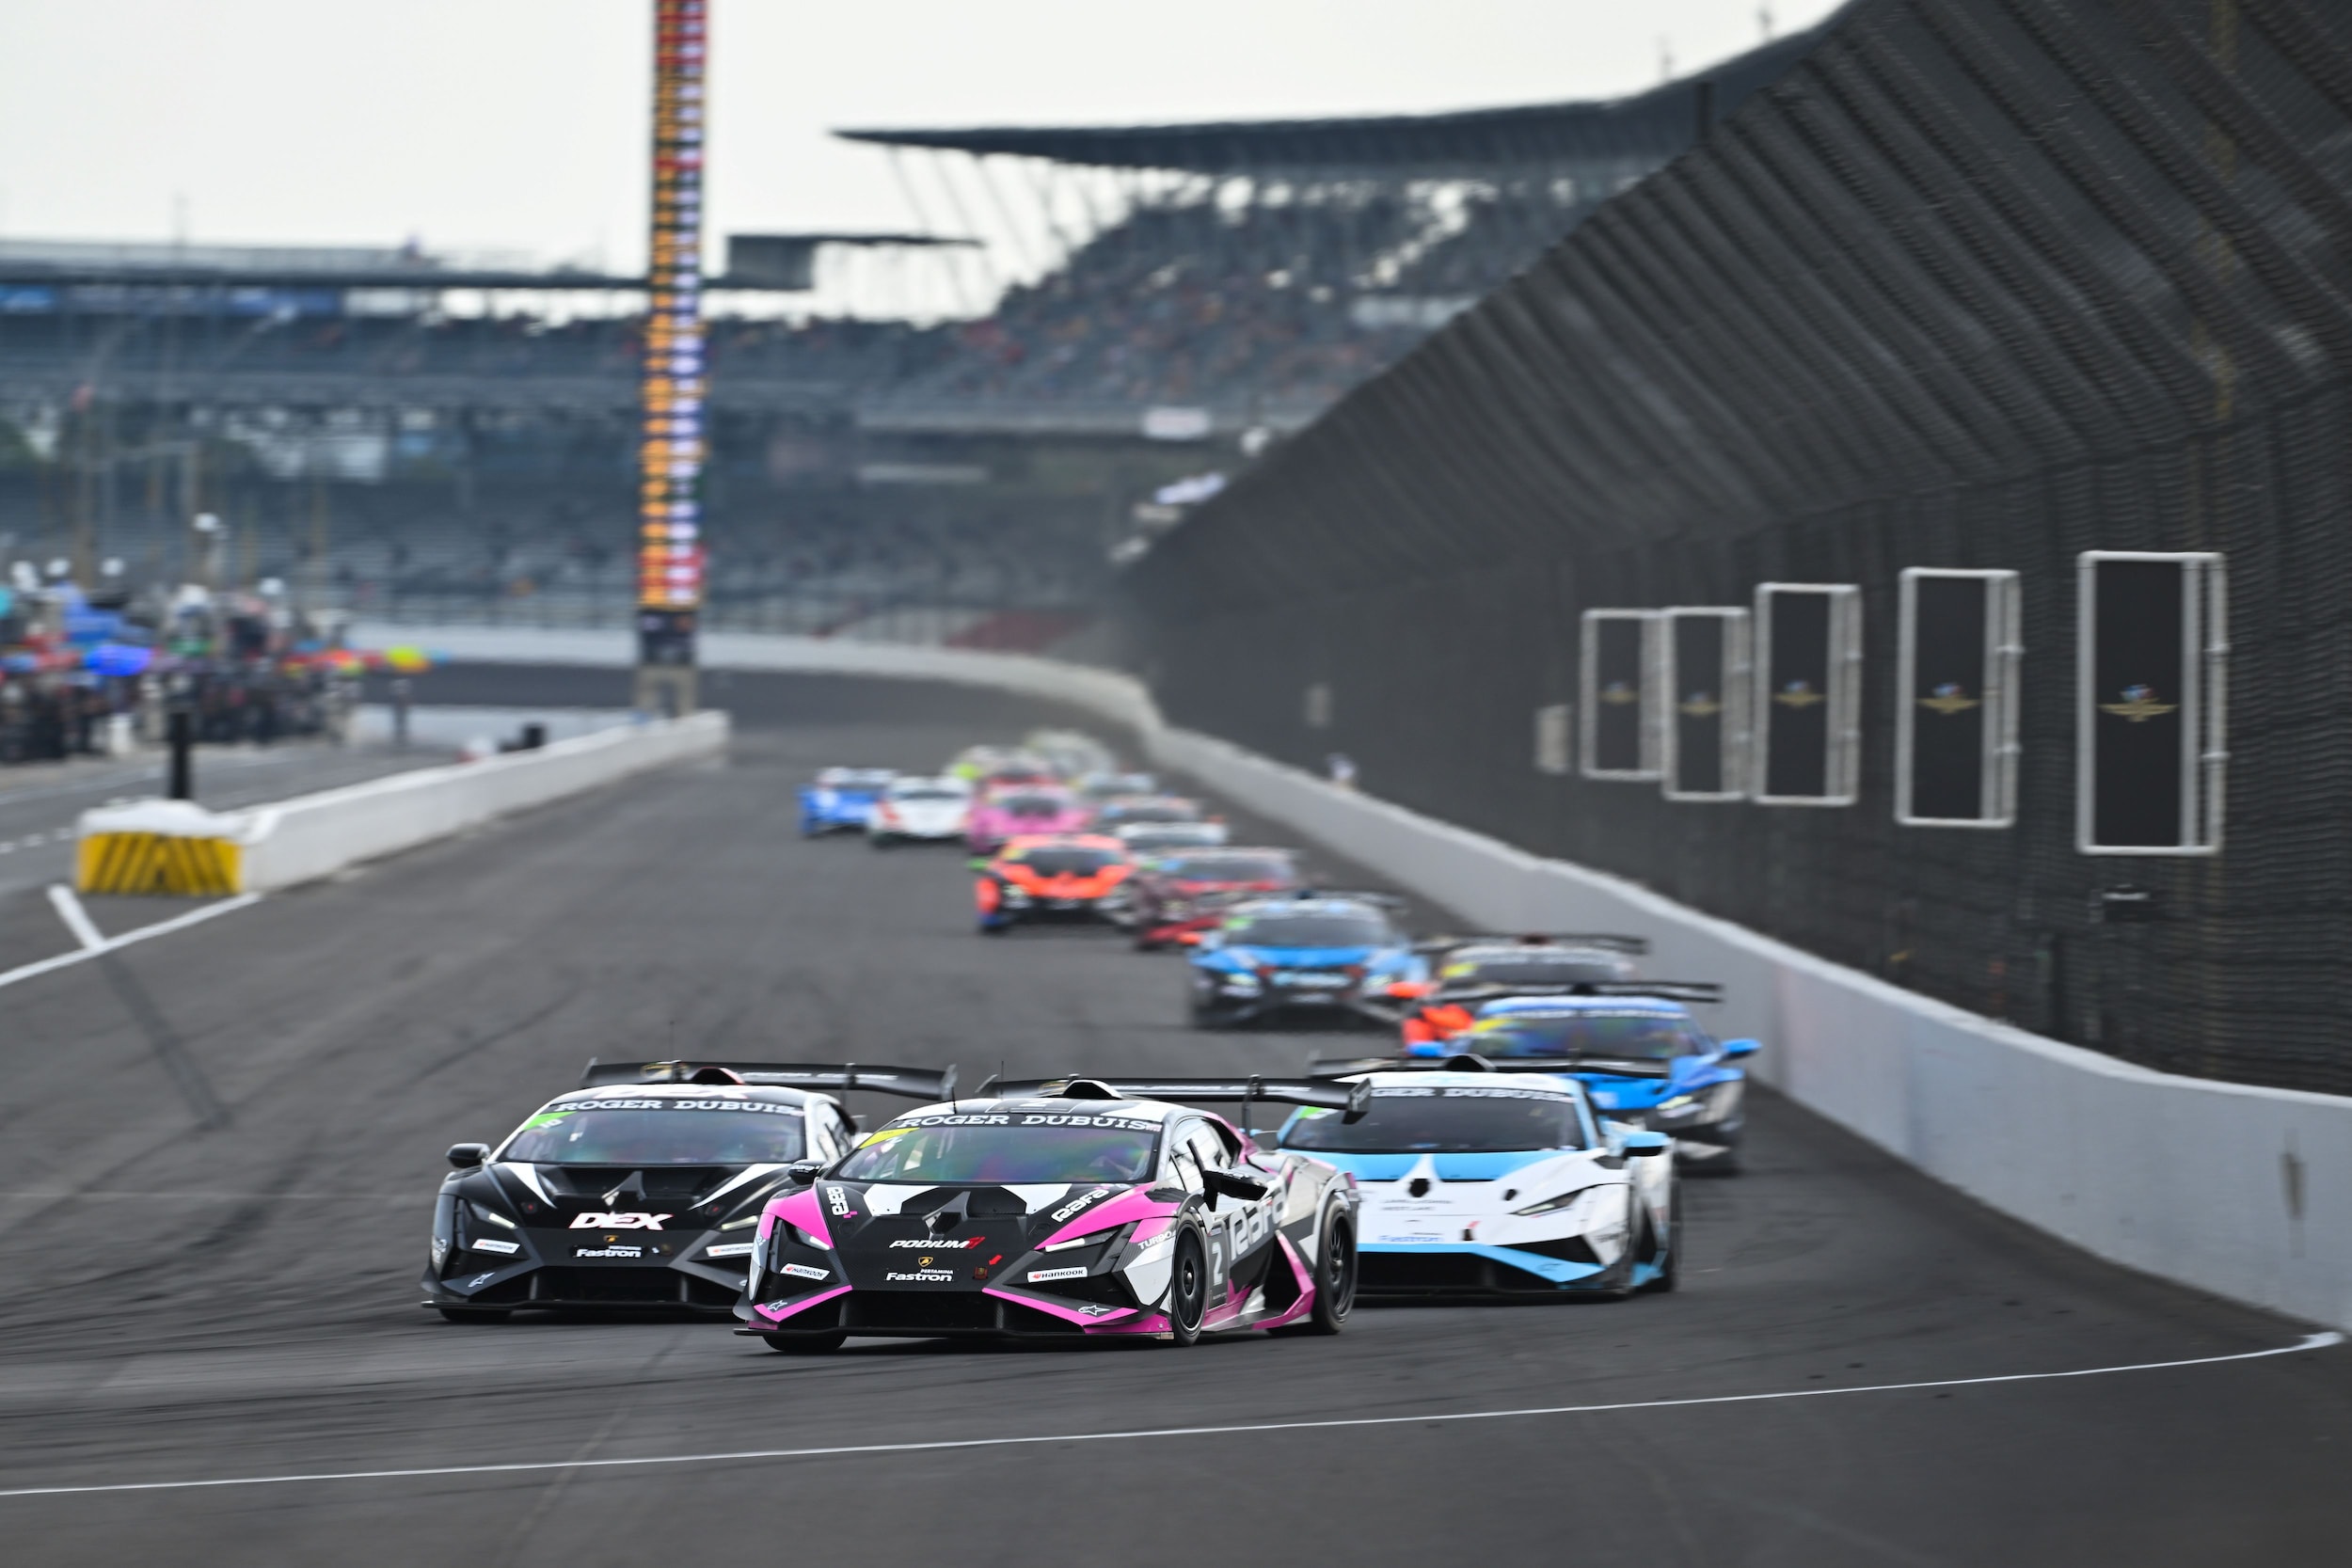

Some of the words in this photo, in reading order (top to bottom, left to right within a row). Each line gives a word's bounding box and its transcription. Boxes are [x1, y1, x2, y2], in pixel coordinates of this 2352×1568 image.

[1371, 1087, 1436, 1098] GER
[555, 1100, 662, 1112] ROGER
[673, 1100, 797, 1115] DUBUIS
[897, 1114, 1009, 1129] ROGER
[1021, 1115, 1147, 1130] DUBUIS
[568, 1212, 675, 1231] DEX
[576, 1248, 642, 1258] Fastron
[1211, 1241, 1223, 1287] 2
[886, 1272, 953, 1282] Fastron
